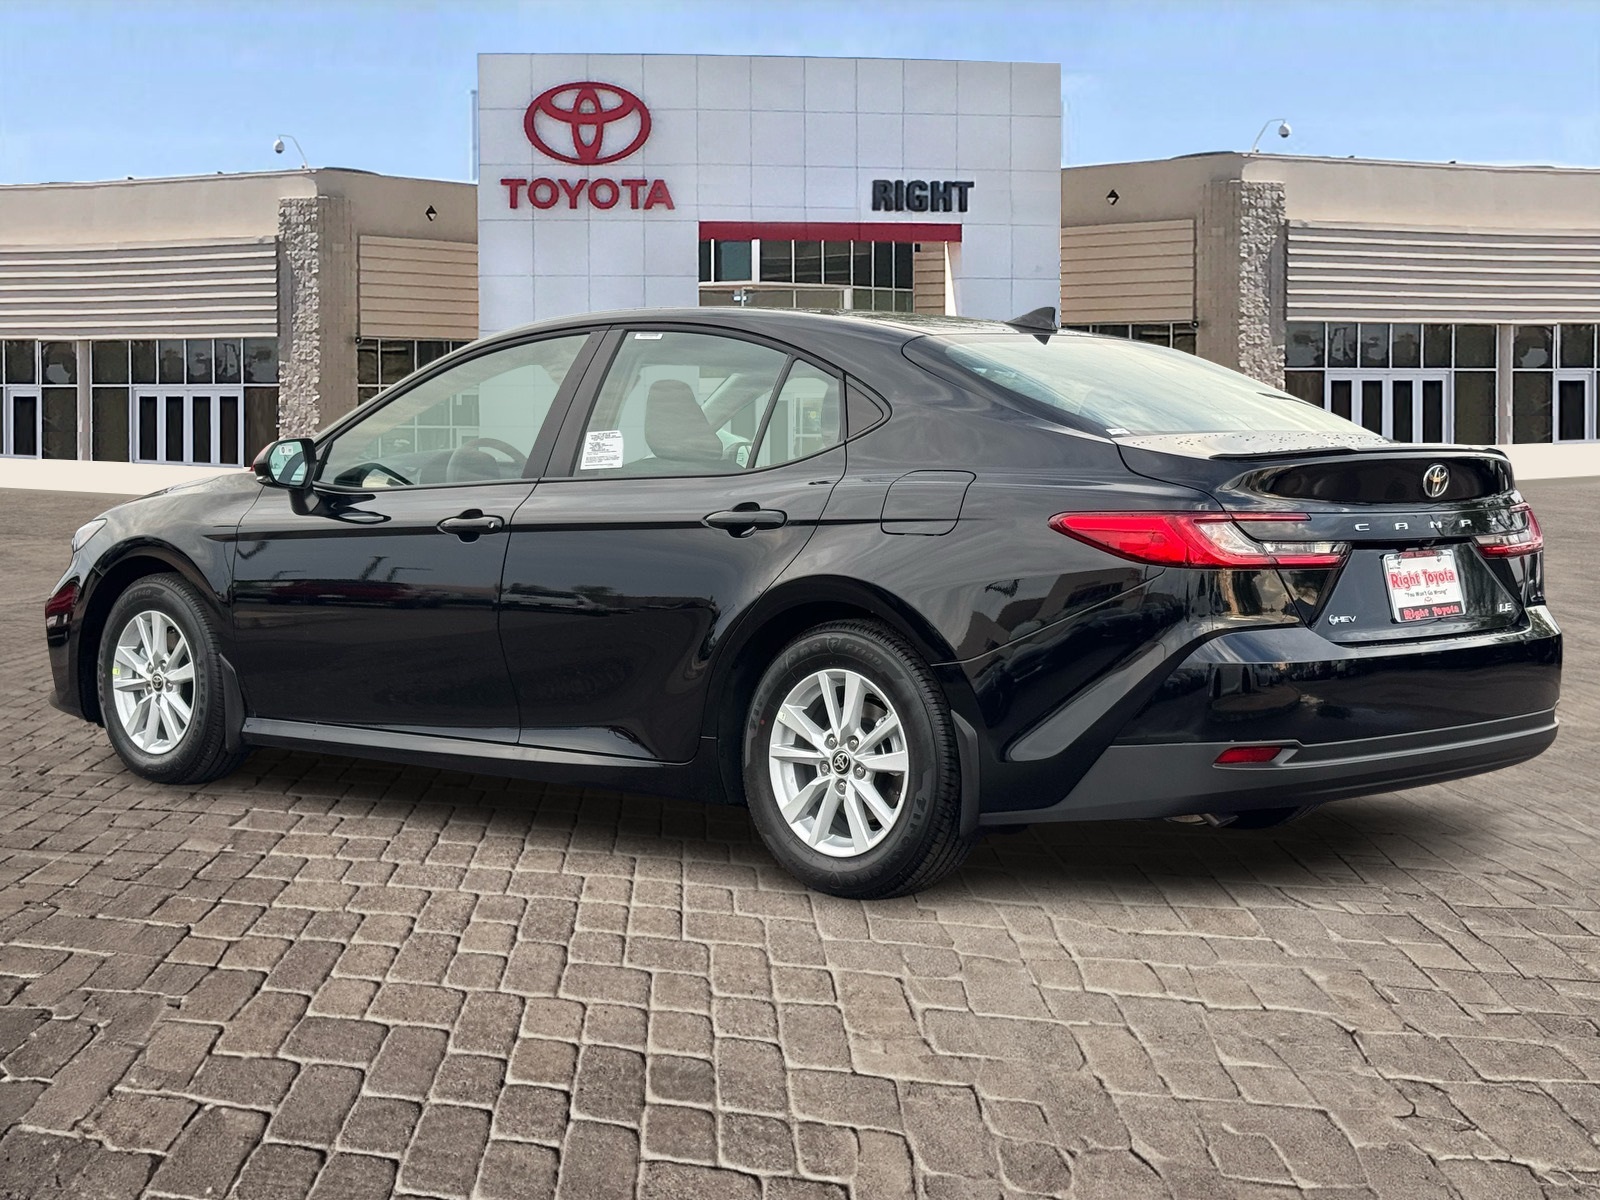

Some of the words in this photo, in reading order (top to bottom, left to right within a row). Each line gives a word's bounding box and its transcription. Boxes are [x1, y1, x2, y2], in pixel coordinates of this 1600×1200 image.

[500, 177, 675, 210] TOYOTA
[872, 179, 975, 212] RIGHT
[1389, 570, 1421, 591] Right
[1421, 568, 1457, 588] Toyota
[1403, 608, 1429, 620] Right
[1432, 605, 1460, 617] Toyota
[1499, 602, 1512, 613] LE
